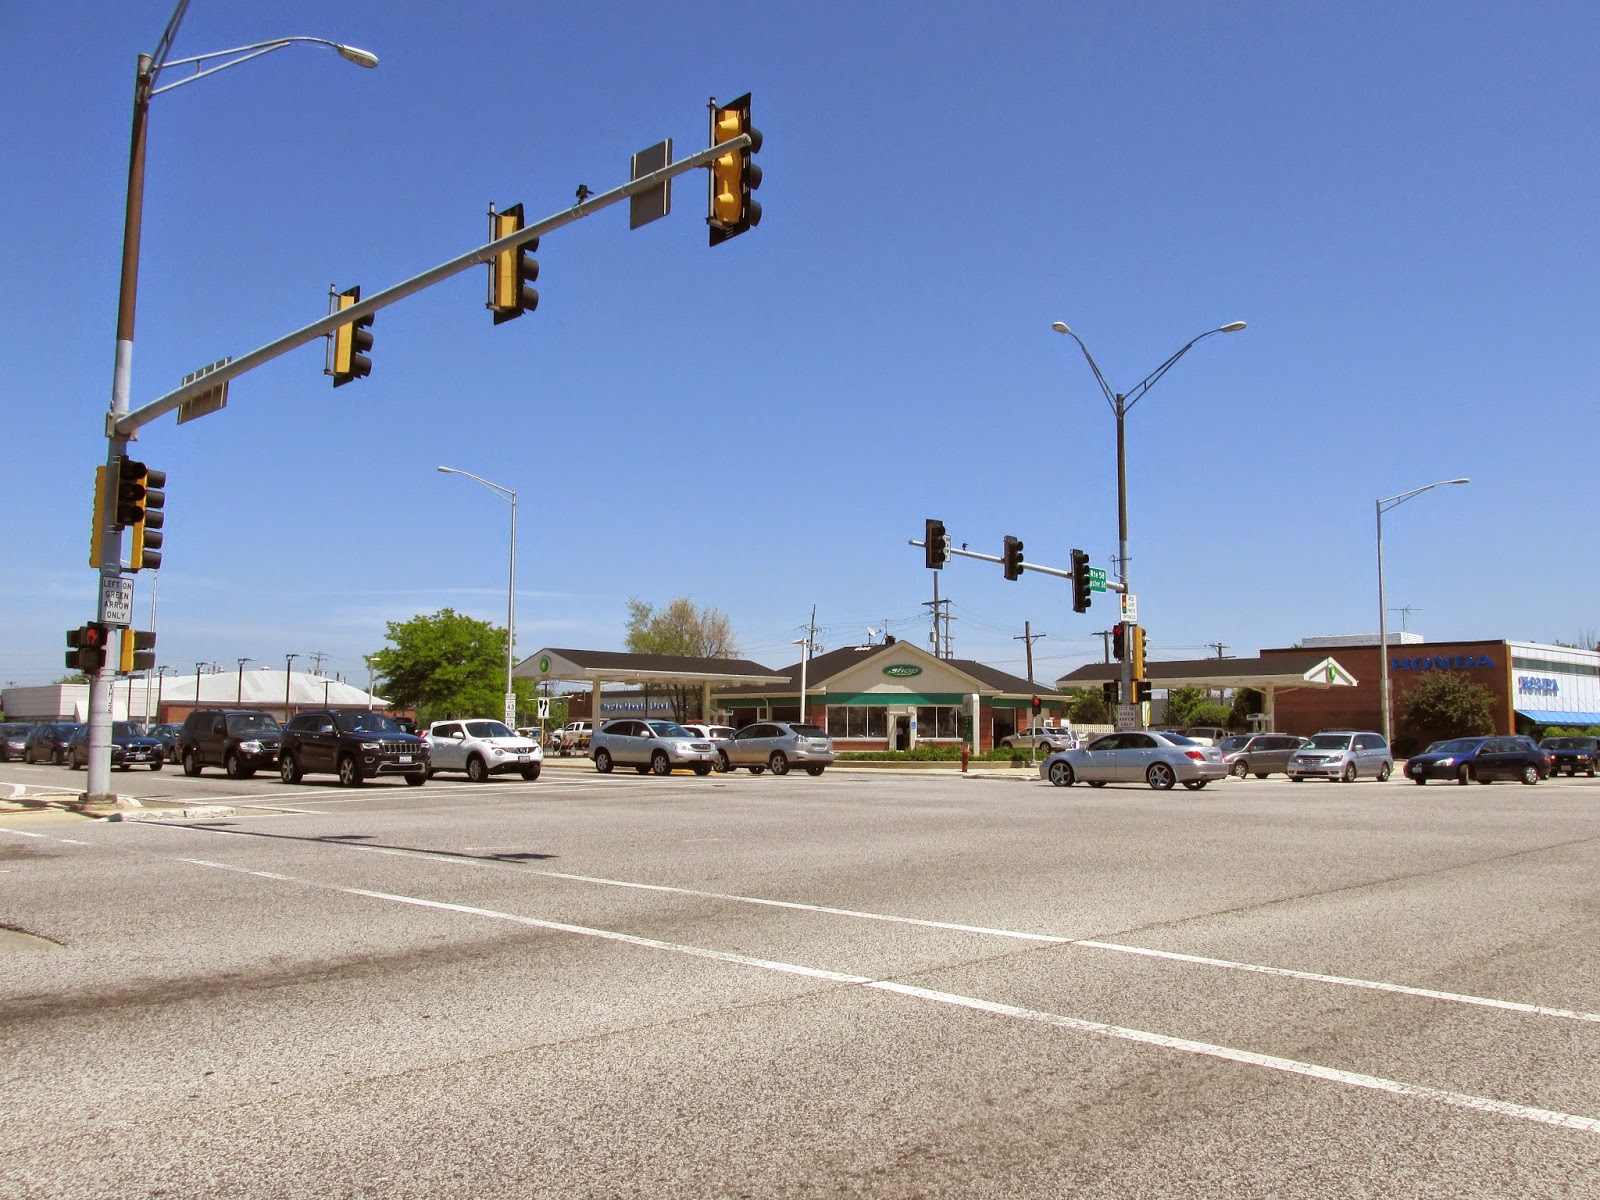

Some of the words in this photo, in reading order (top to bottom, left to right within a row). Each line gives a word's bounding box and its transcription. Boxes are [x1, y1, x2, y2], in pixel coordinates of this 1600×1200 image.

[103, 580, 120, 588] LEFT
[122, 582, 132, 590] ON
[105, 590, 129, 600] GREEN
[103, 600, 130, 610] ARROW
[106, 610, 126, 620] ONLY
[1392, 655, 1496, 670] HONDA
[1518, 676, 1560, 691] HONDA
